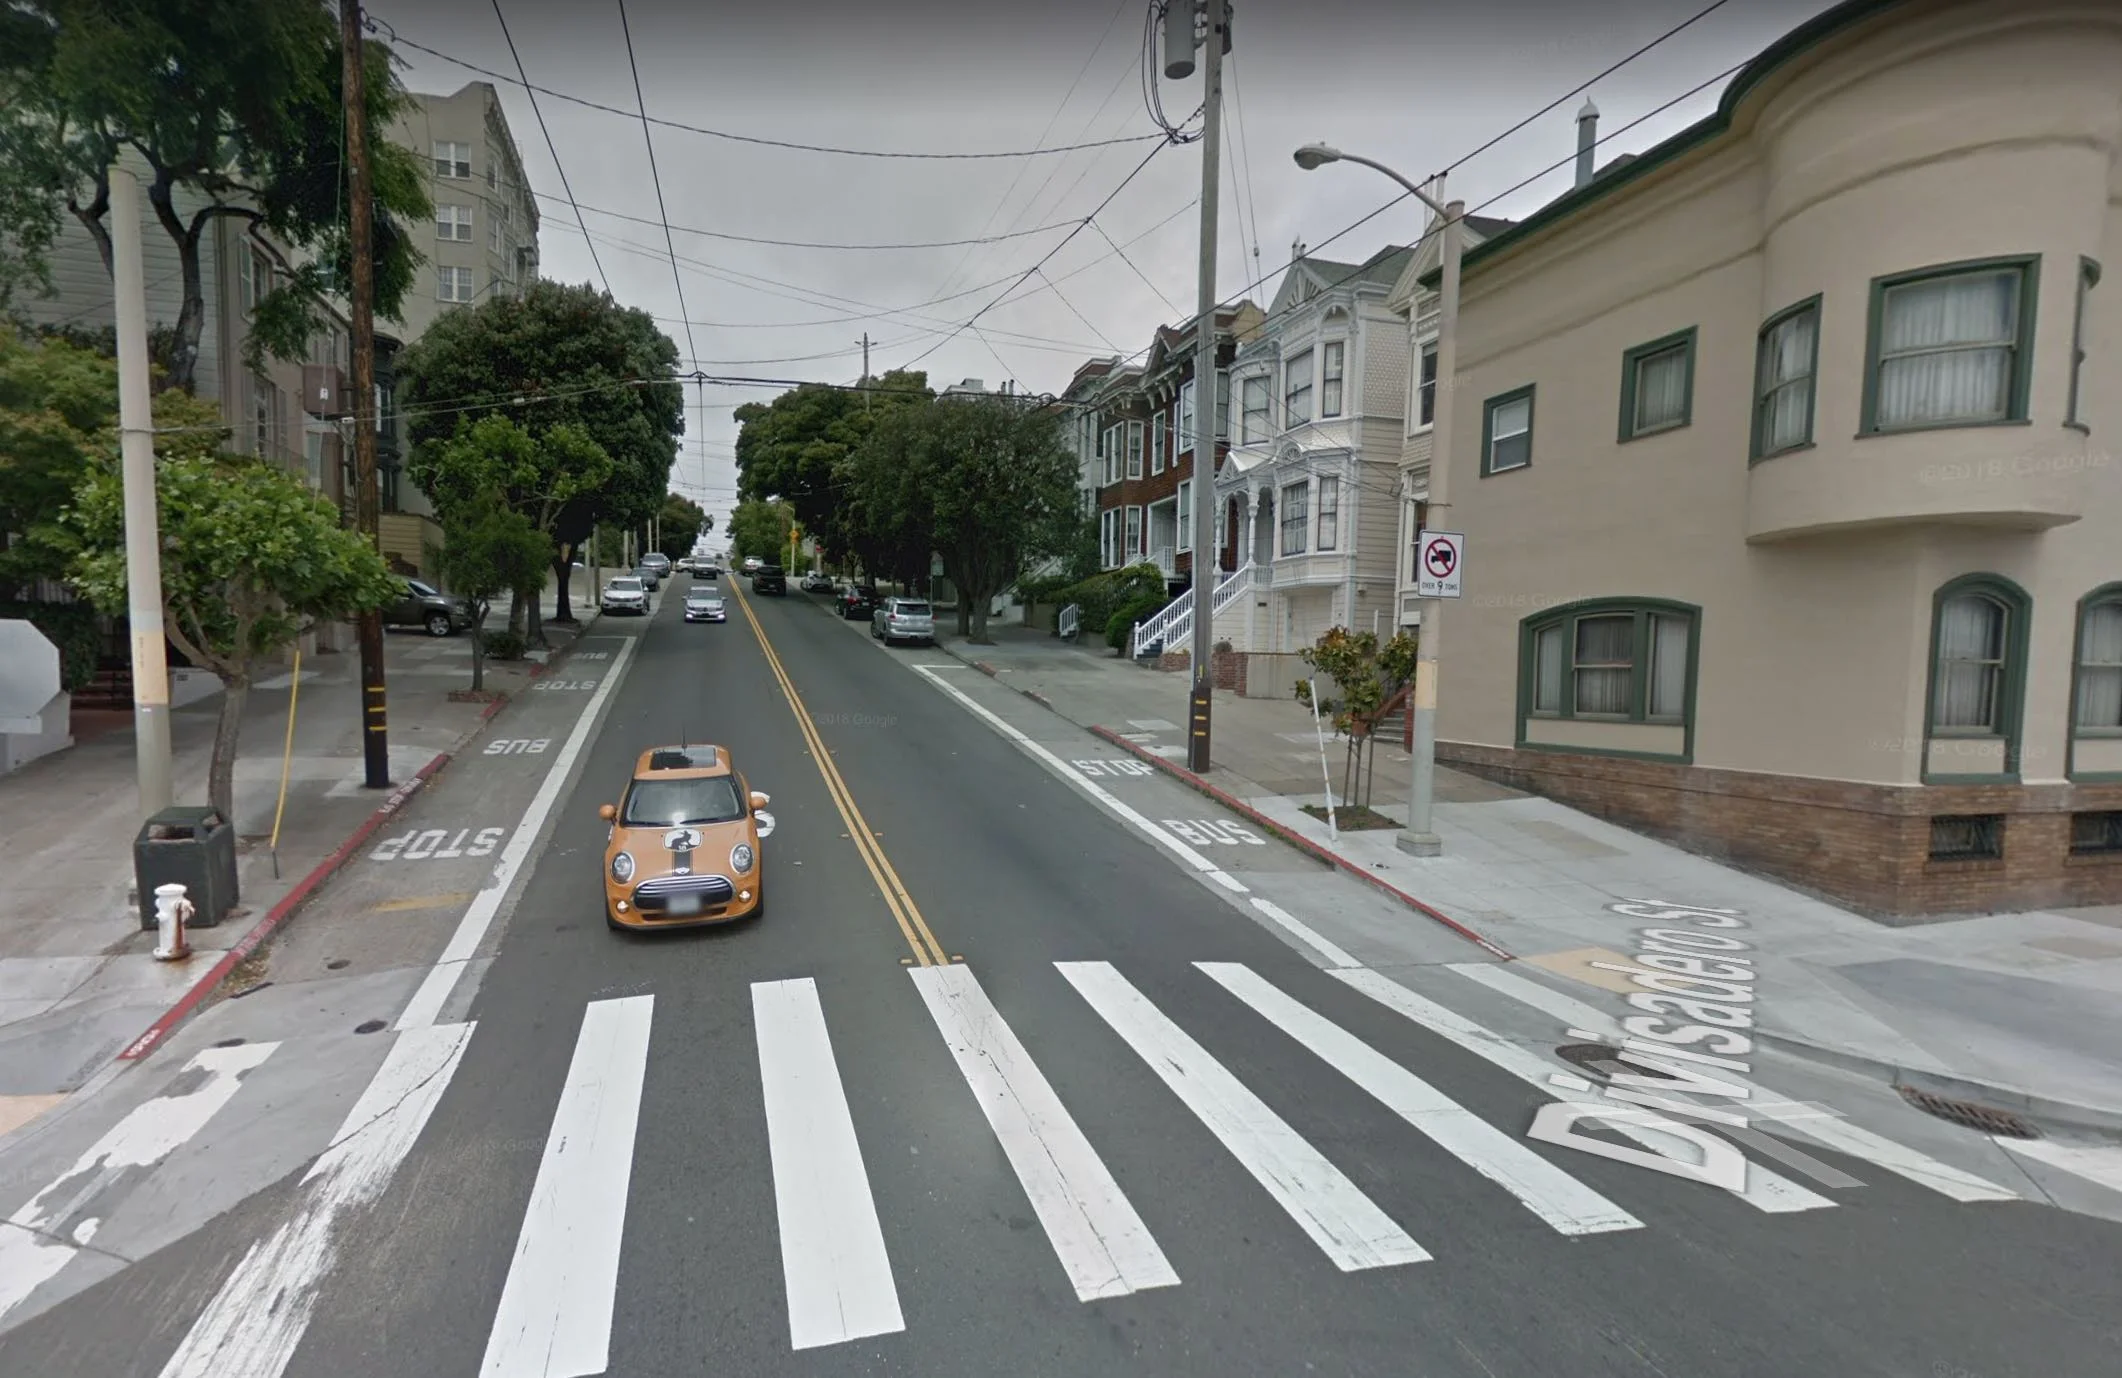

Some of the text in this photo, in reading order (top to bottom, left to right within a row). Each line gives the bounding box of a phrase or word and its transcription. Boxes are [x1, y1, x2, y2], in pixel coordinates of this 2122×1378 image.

[1437, 581, 1443, 591] 9
[532, 680, 598, 690] STOP
[483, 738, 552, 755] BUS
[1071, 759, 1155, 776] STOP
[1161, 819, 1267, 845] BUS
[368, 827, 505, 861] STOP
